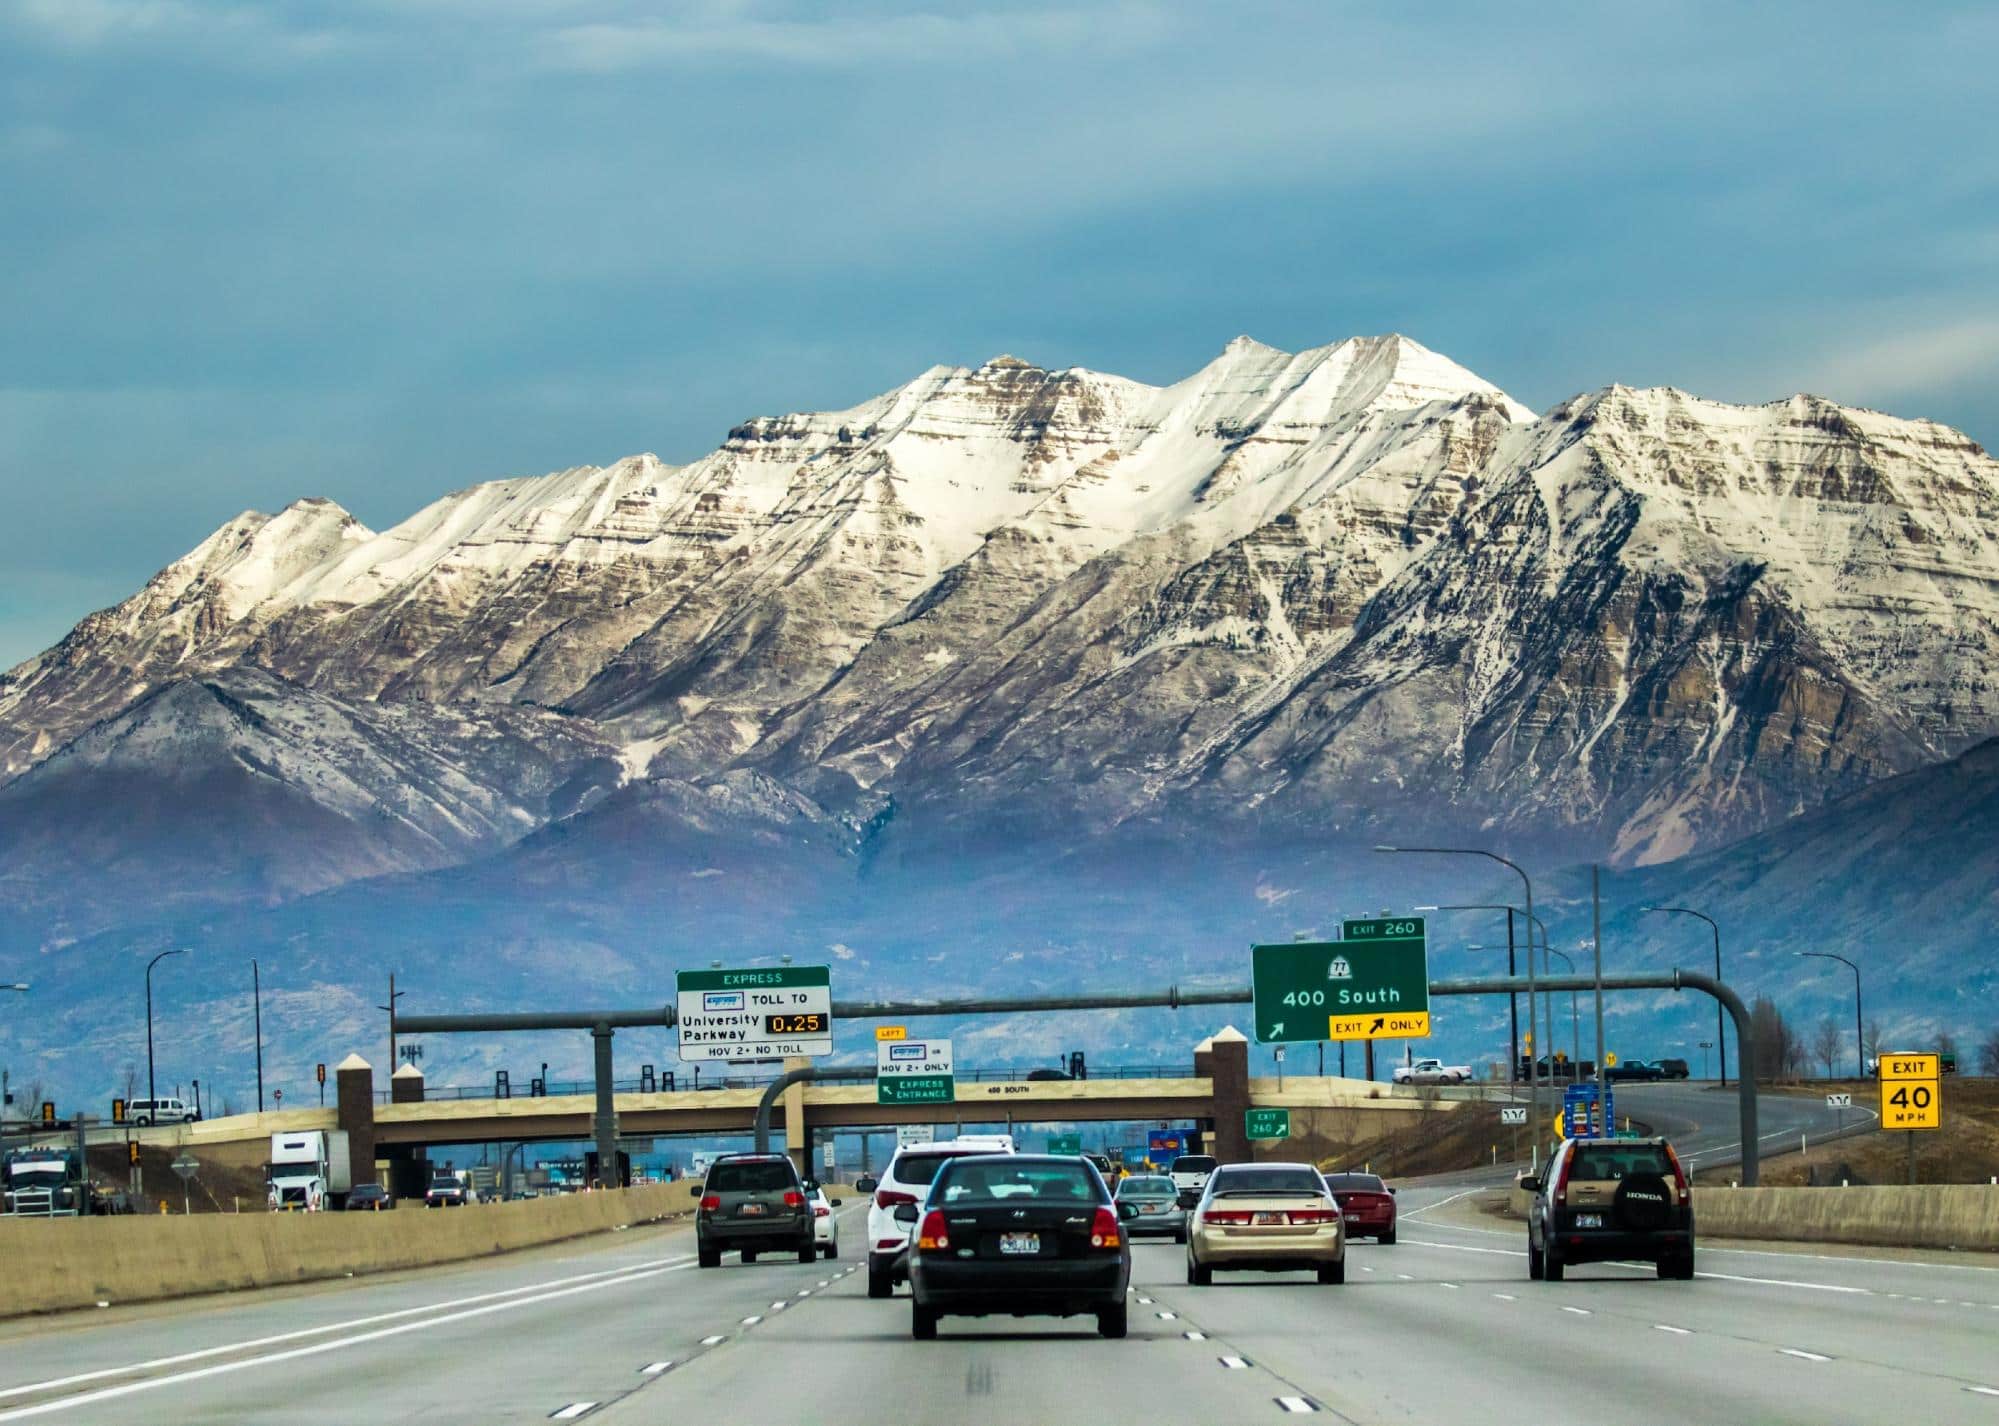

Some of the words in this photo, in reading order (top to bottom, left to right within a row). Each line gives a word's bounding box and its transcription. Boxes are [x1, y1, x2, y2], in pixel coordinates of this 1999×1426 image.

[1352, 925, 1375, 935] EXIT
[1385, 922, 1415, 935] 260
[1333, 962, 1346, 972] 77
[723, 973, 783, 985] EXPRESS
[752, 995, 784, 1005] TOLL
[791, 994, 808, 1004] TO
[1283, 991, 1325, 1006] 400
[1339, 988, 1400, 1004] South
[683, 1015, 759, 1028] University
[772, 1015, 819, 1032] 0.25
[1335, 1022, 1362, 1033] EXIT
[1390, 1020, 1423, 1031] ONLY
[684, 1029, 746, 1042] Parkway
[709, 1047, 731, 1056] HOV
[756, 1046, 771, 1054] NO
[777, 1044, 803, 1053] TOLL
[924, 1063, 949, 1071] ONLY
[1893, 1062, 1926, 1073] EXIT
[900, 1080, 944, 1089] EXPRESS
[896, 1090, 947, 1099] ENTRANCE
[1889, 1086, 1931, 1109] 40
[1895, 1113, 1926, 1122] MPH
[1626, 1191, 1663, 1201] HONDA
